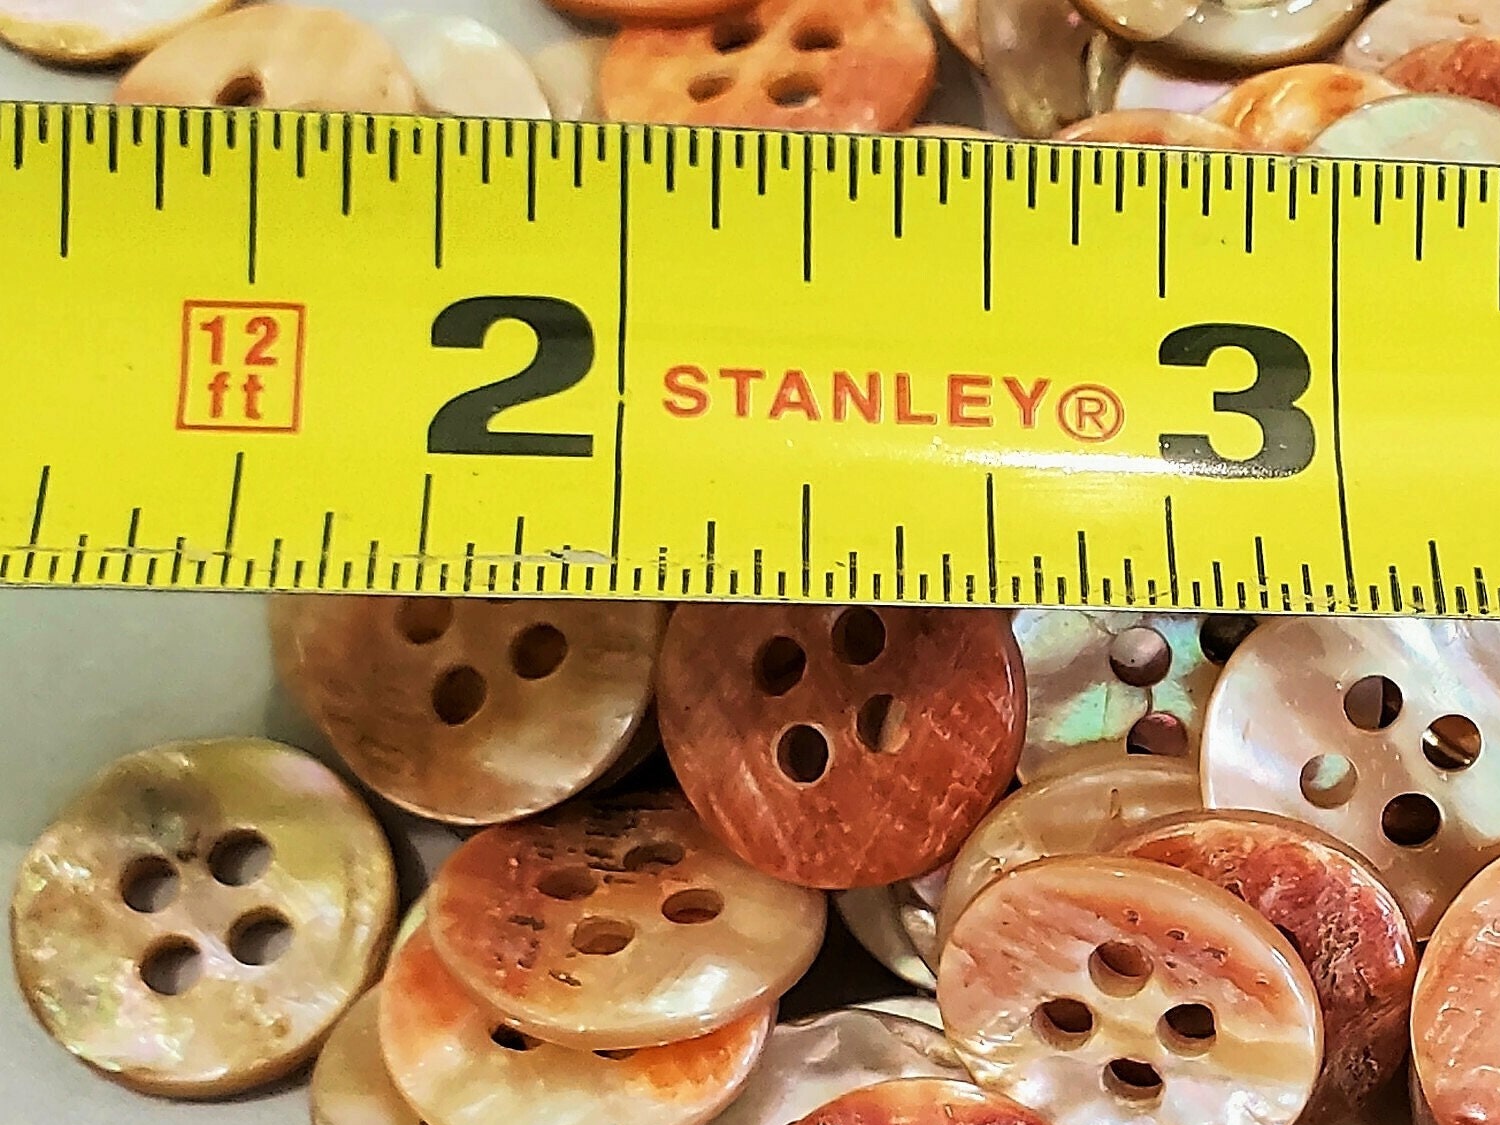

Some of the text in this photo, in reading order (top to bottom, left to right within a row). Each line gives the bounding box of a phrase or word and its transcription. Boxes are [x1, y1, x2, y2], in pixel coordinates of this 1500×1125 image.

[201, 316, 279, 368] 12
[426, 294, 597, 458] 2
[207, 370, 264, 422] ft
[1157, 321, 1317, 480] 3
